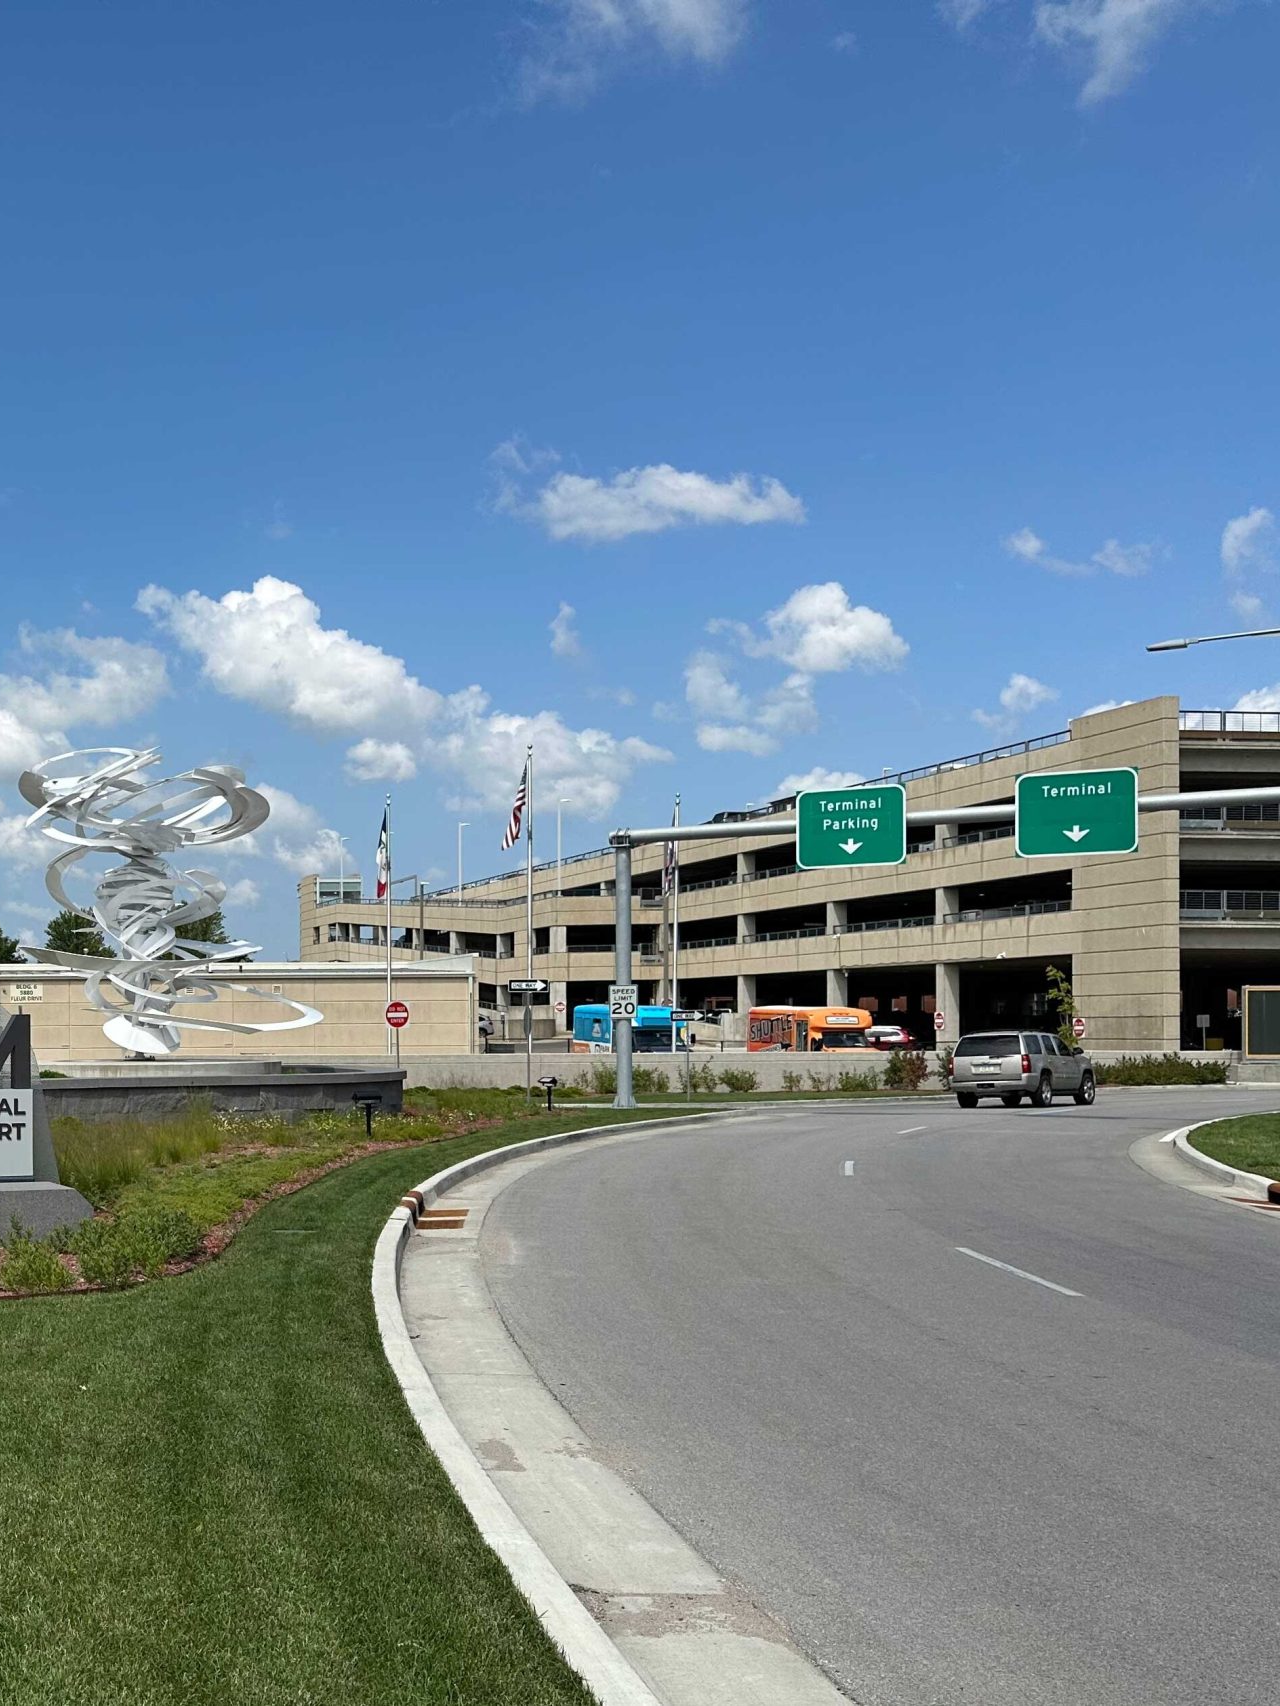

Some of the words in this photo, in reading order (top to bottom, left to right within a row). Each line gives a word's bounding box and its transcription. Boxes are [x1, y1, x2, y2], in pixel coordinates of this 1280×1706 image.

[1042, 782, 1112, 798] Terminal
[819, 797, 882, 812] Terminal
[823, 816, 879, 831] Parking
[612, 1002, 635, 1015] 20
[750, 1013, 792, 1040] SHUTTLE
